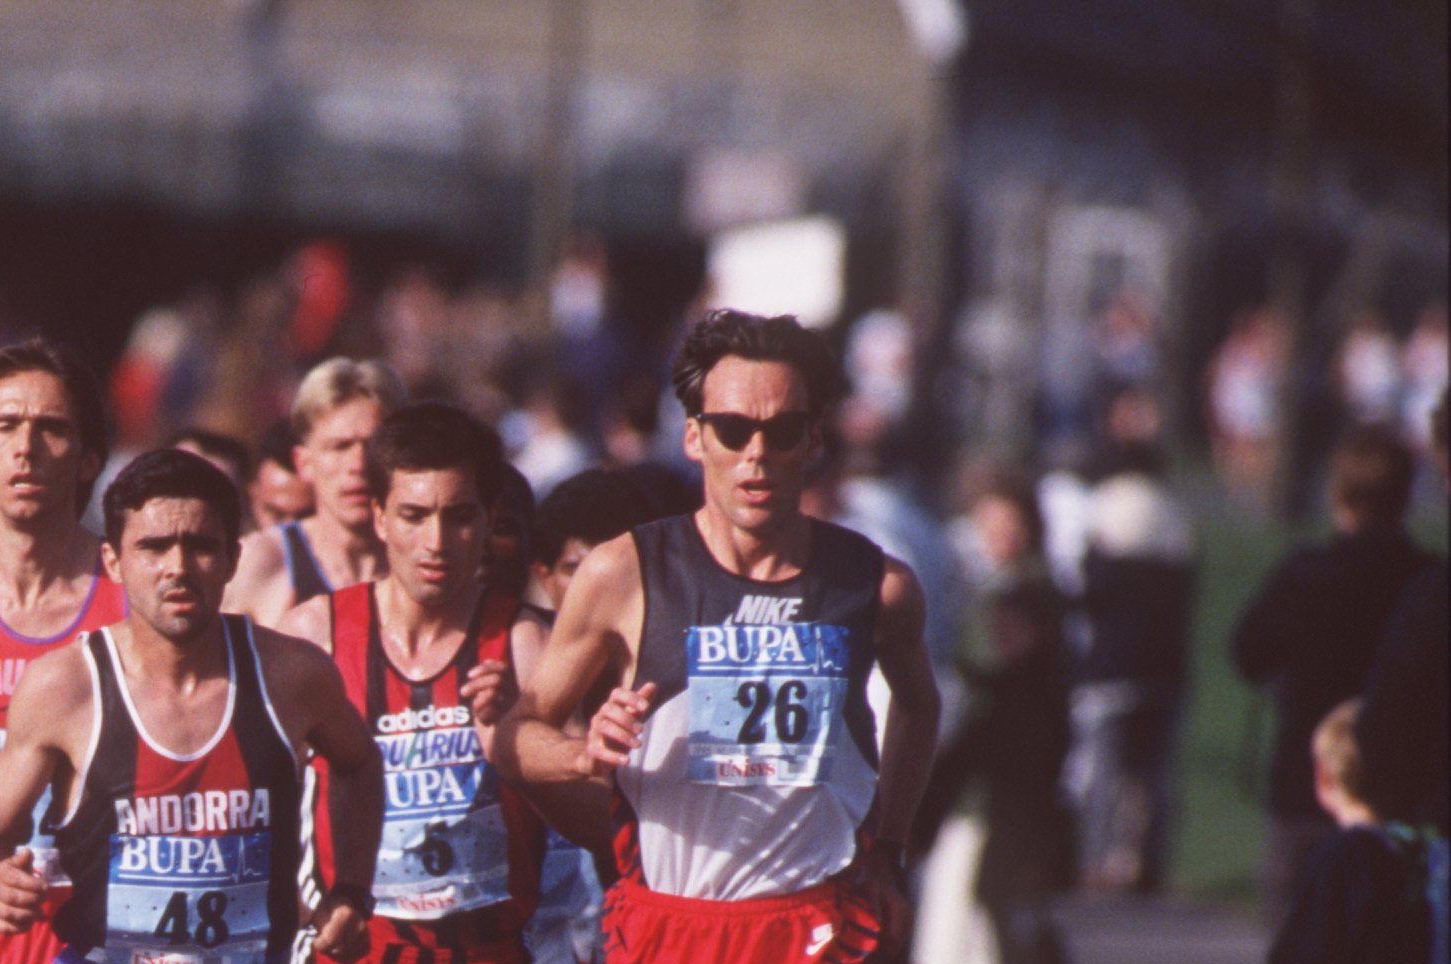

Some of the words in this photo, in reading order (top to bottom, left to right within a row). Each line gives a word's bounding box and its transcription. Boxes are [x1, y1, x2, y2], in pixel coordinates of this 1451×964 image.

[735, 595, 804, 624] NIKE
[696, 625, 806, 663] BUPA
[377, 705, 471, 733] adidas
[737, 679, 809, 745] 26
[114, 788, 271, 836] ANDORRA
[118, 836, 227, 874] BUPA
[153, 890, 230, 949] 48
